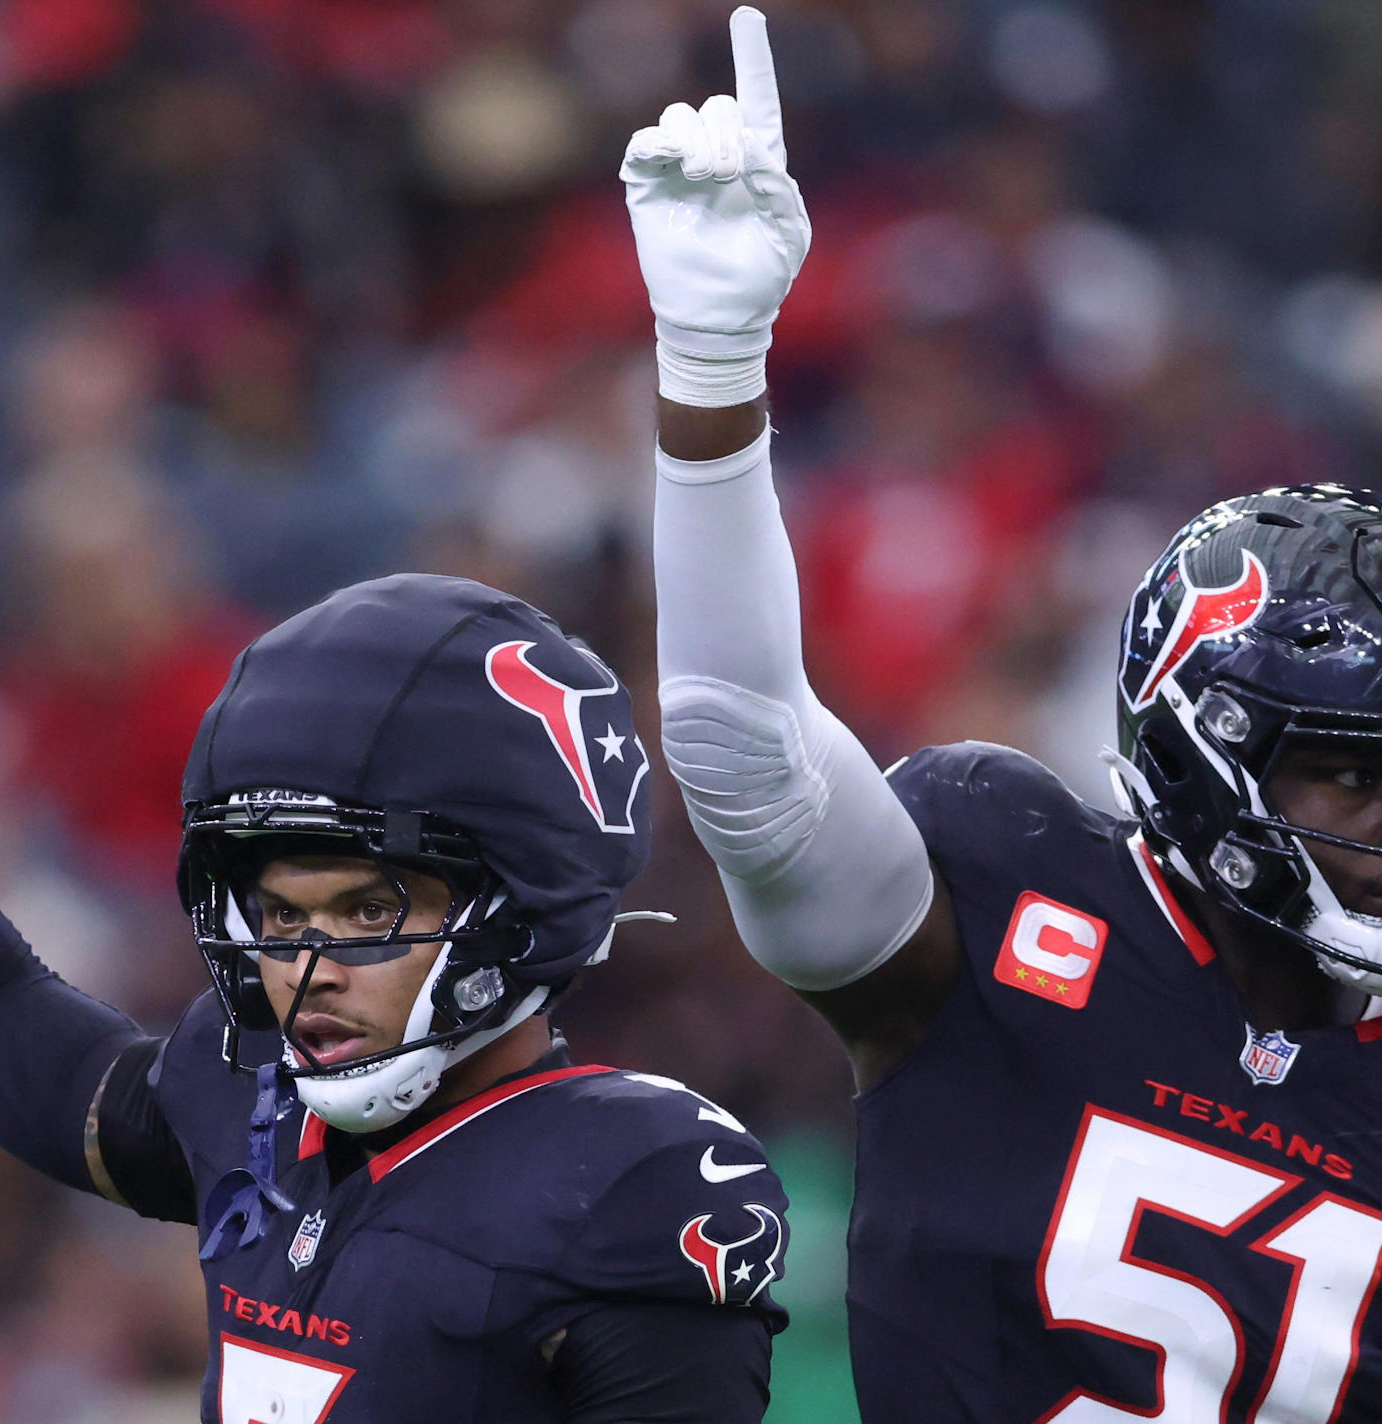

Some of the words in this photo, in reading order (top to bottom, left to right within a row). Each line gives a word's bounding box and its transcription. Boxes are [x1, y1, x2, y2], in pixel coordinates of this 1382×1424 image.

[1011, 901, 1098, 980] C
[1247, 1046, 1281, 1077] NFL
[1143, 1079, 1355, 1180] TEXANS
[220, 1284, 352, 1347] TEXANS
